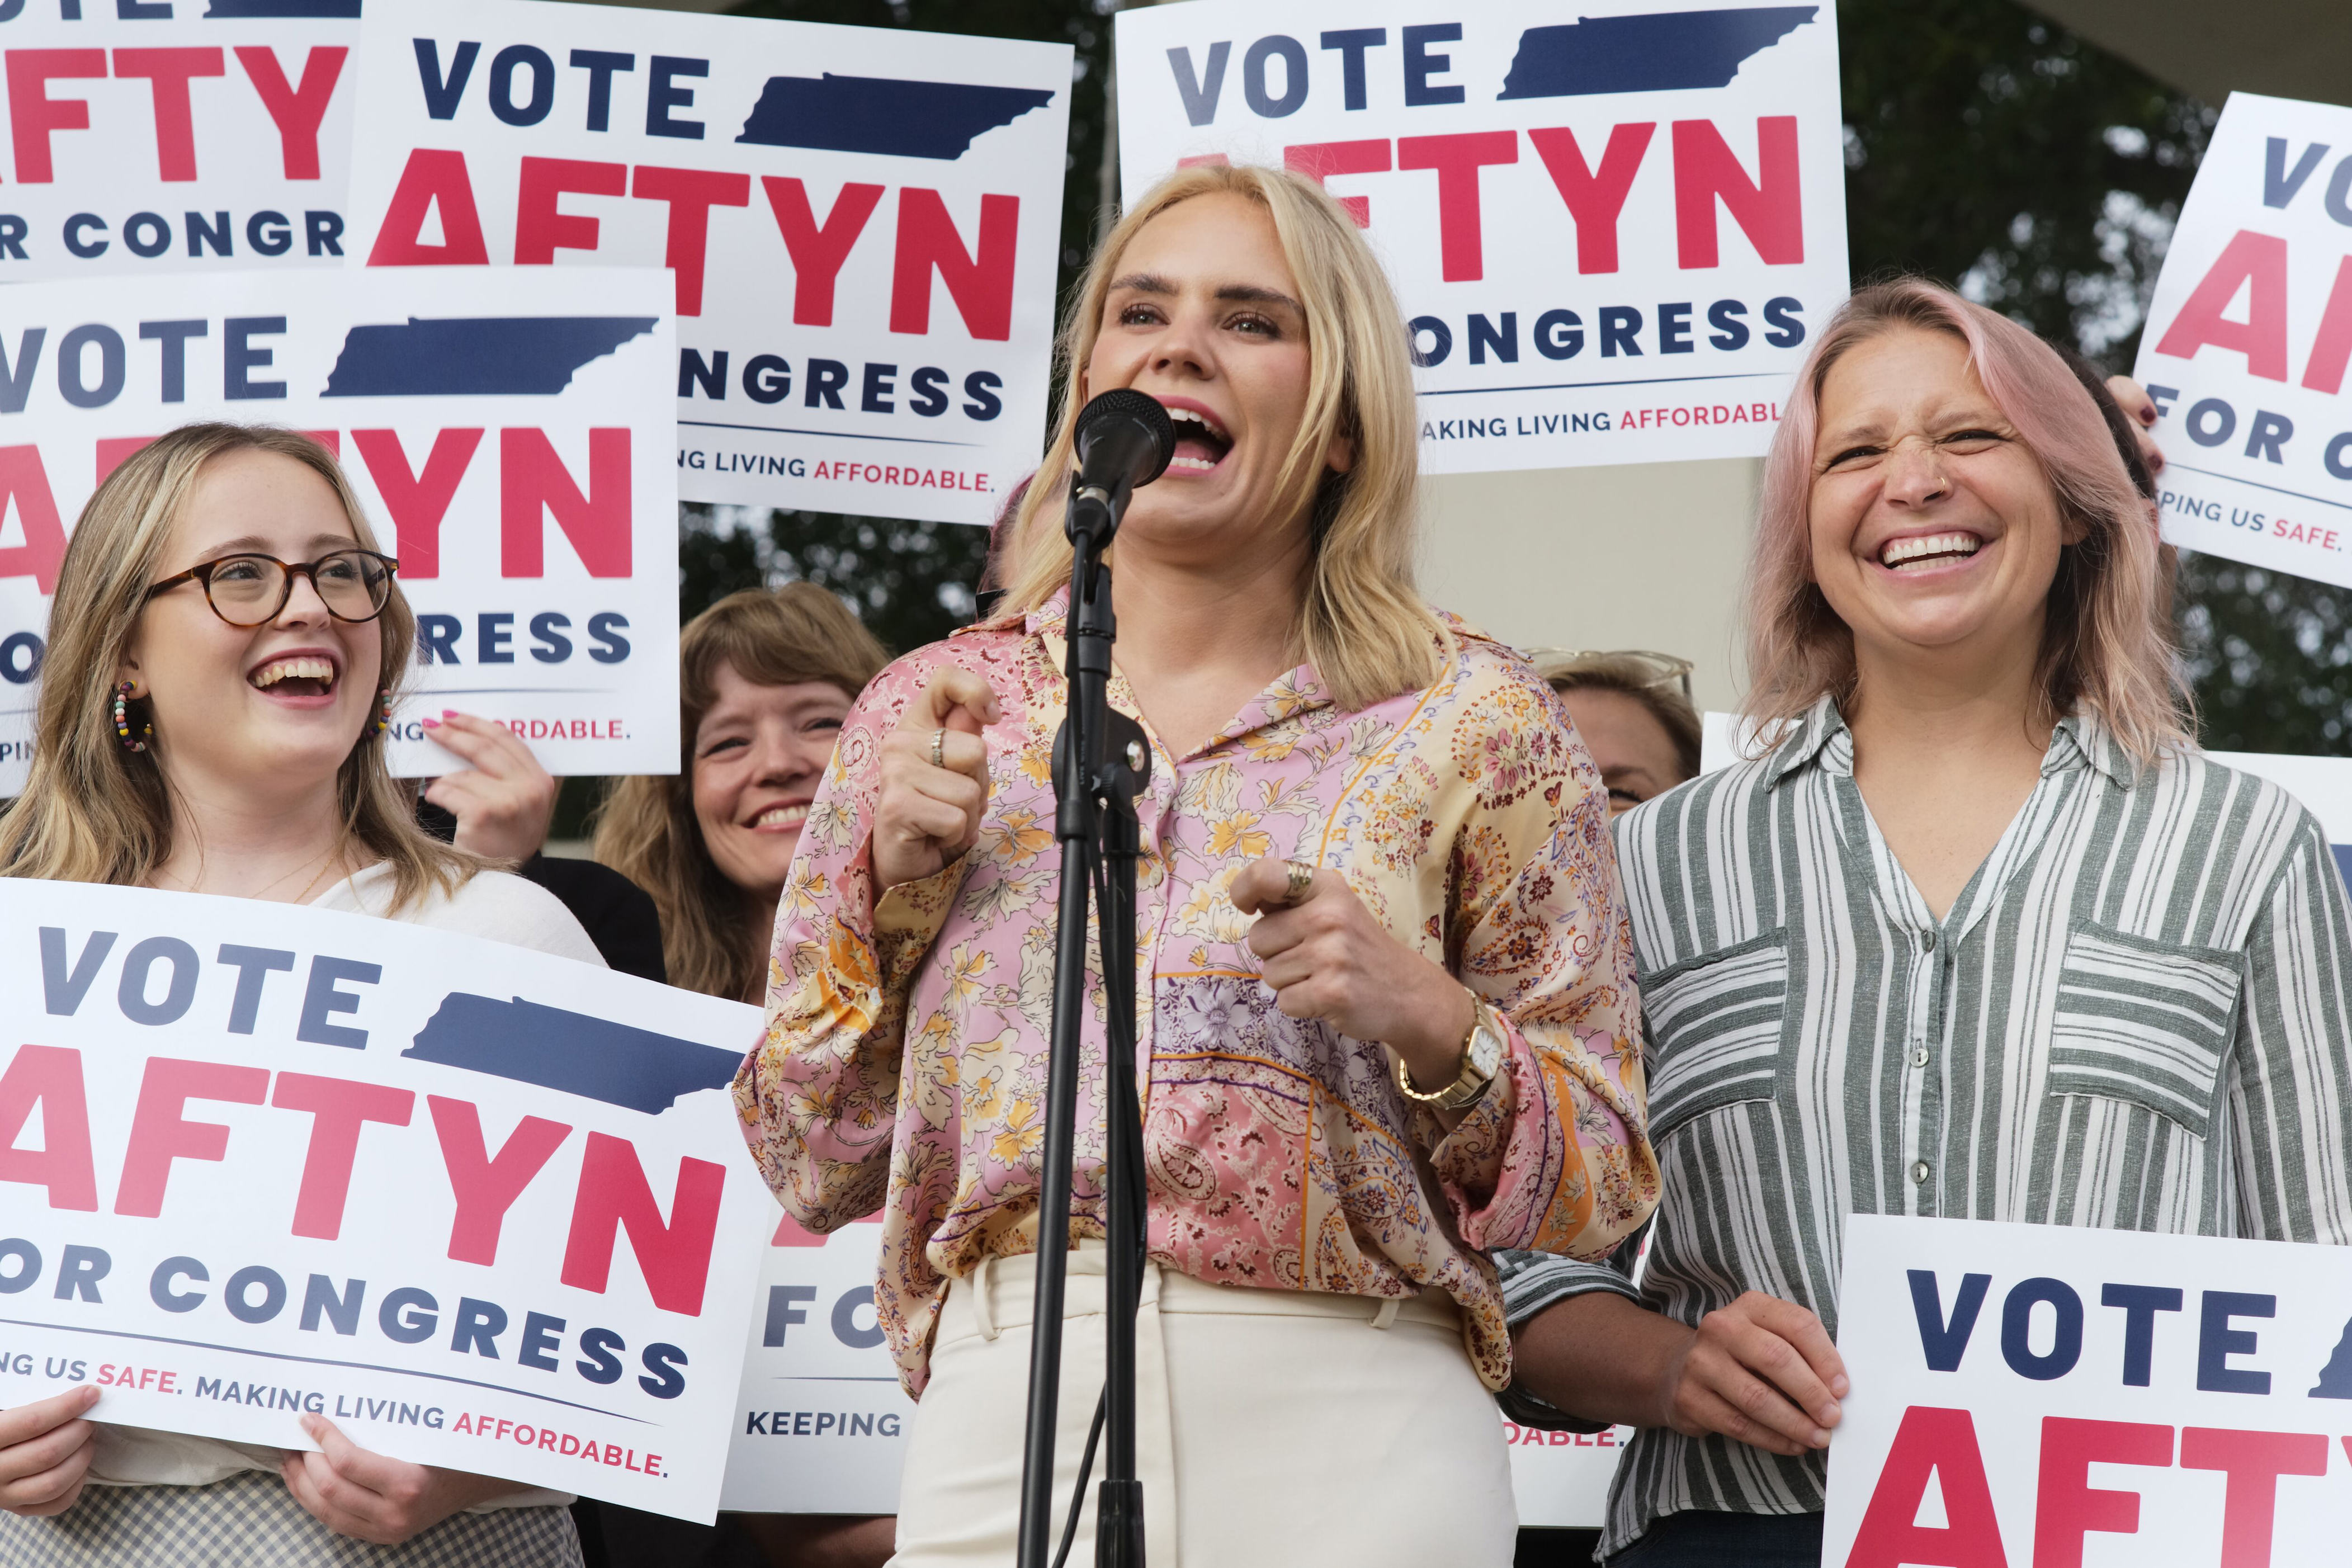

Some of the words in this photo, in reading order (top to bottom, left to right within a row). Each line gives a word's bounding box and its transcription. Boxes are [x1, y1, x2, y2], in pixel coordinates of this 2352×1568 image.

[0, 46, 350, 183] FTY
[413, 37, 709, 140] VOTE
[1166, 22, 1465, 127] VOTE
[63, 210, 344, 259] CONGR
[365, 148, 1019, 342] AFTYN
[0, 315, 287, 413] VOTE
[1406, 296, 1806, 367] ONGRESS
[678, 348, 1003, 421] NGRESS
[1422, 418, 1506, 440] AKING
[1517, 412, 1611, 436] LIVING
[1620, 402, 1781, 429] AFFORDABL
[715, 452, 806, 477] LIVING
[814, 460, 995, 493] AFFORDABLE.
[2157, 489, 2222, 522] PING
[2231, 508, 2265, 532] US
[2273, 519, 2343, 552] SAFE.
[416, 611, 631, 665] RESS
[493, 719, 631, 740] RDABLE.
[39, 925, 383, 1050] VOTE
[0, 1043, 727, 1317] AFTYN
[0, 1238, 112, 1303] OR
[150, 1255, 688, 1400] CONGRESS
[763, 1285, 887, 1349] FO
[1906, 1269, 2277, 1395] VOTE
[45, 1357, 87, 1382] US
[96, 1363, 183, 1395] SAFE.
[195, 1376, 325, 1415] MAKING
[335, 1394, 445, 1430] LIVING
[452, 1412, 668, 1479] AFFORDABLE.
[746, 1411, 901, 1437] KEEPING
[1844, 1405, 2352, 1568] AFT
